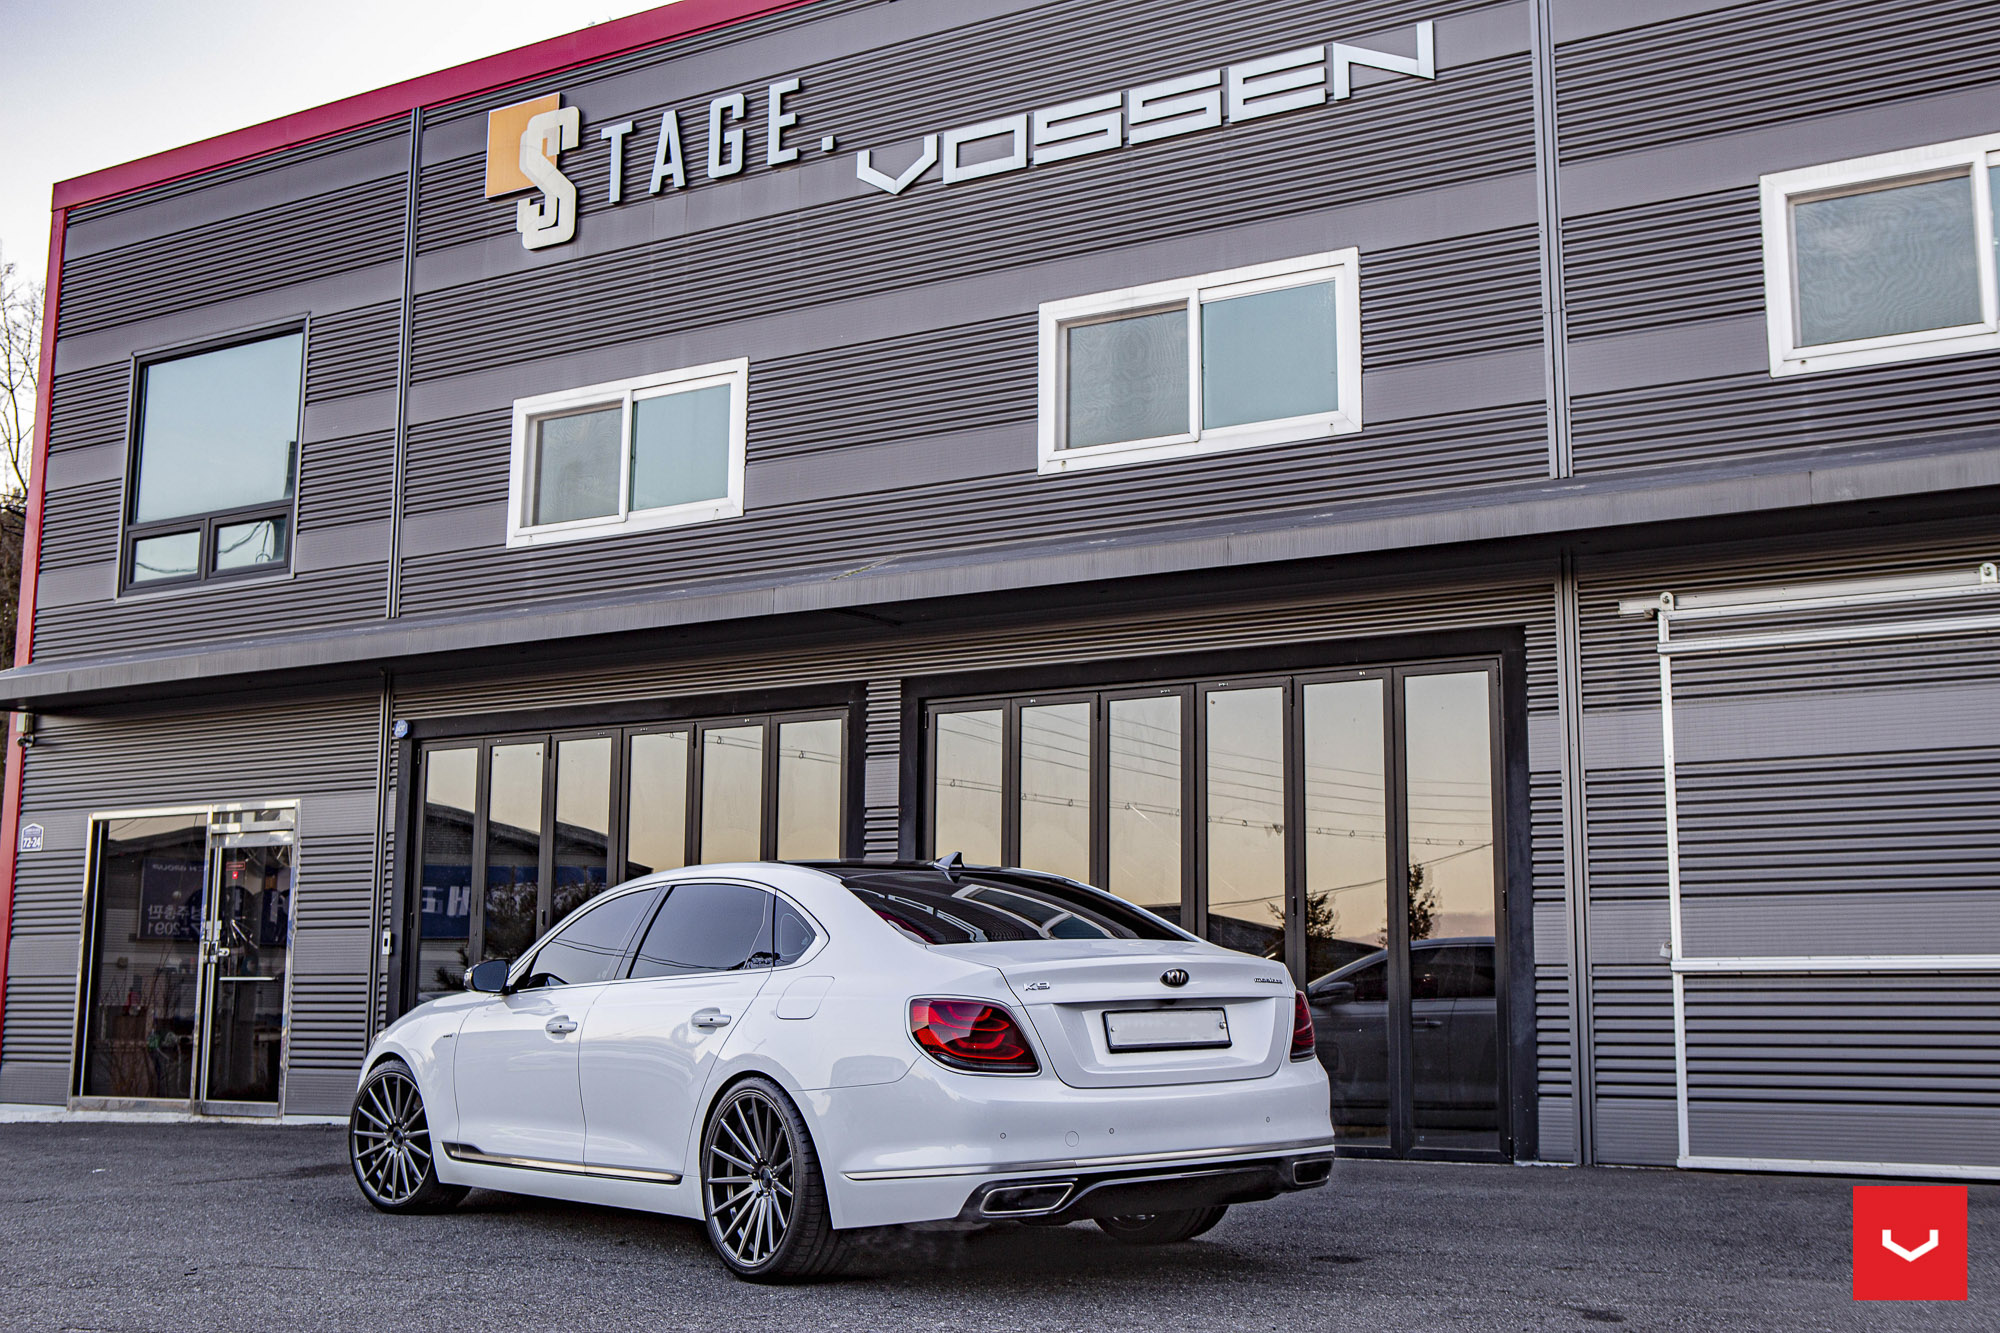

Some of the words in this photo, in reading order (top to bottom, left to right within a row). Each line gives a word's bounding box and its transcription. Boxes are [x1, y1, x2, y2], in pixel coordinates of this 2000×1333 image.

[857, 20, 1435, 195] VOSSEN
[23, 836, 41, 848] 72-24
[1166, 970, 1187, 983] KIA
[1023, 981, 1050, 991] K9
